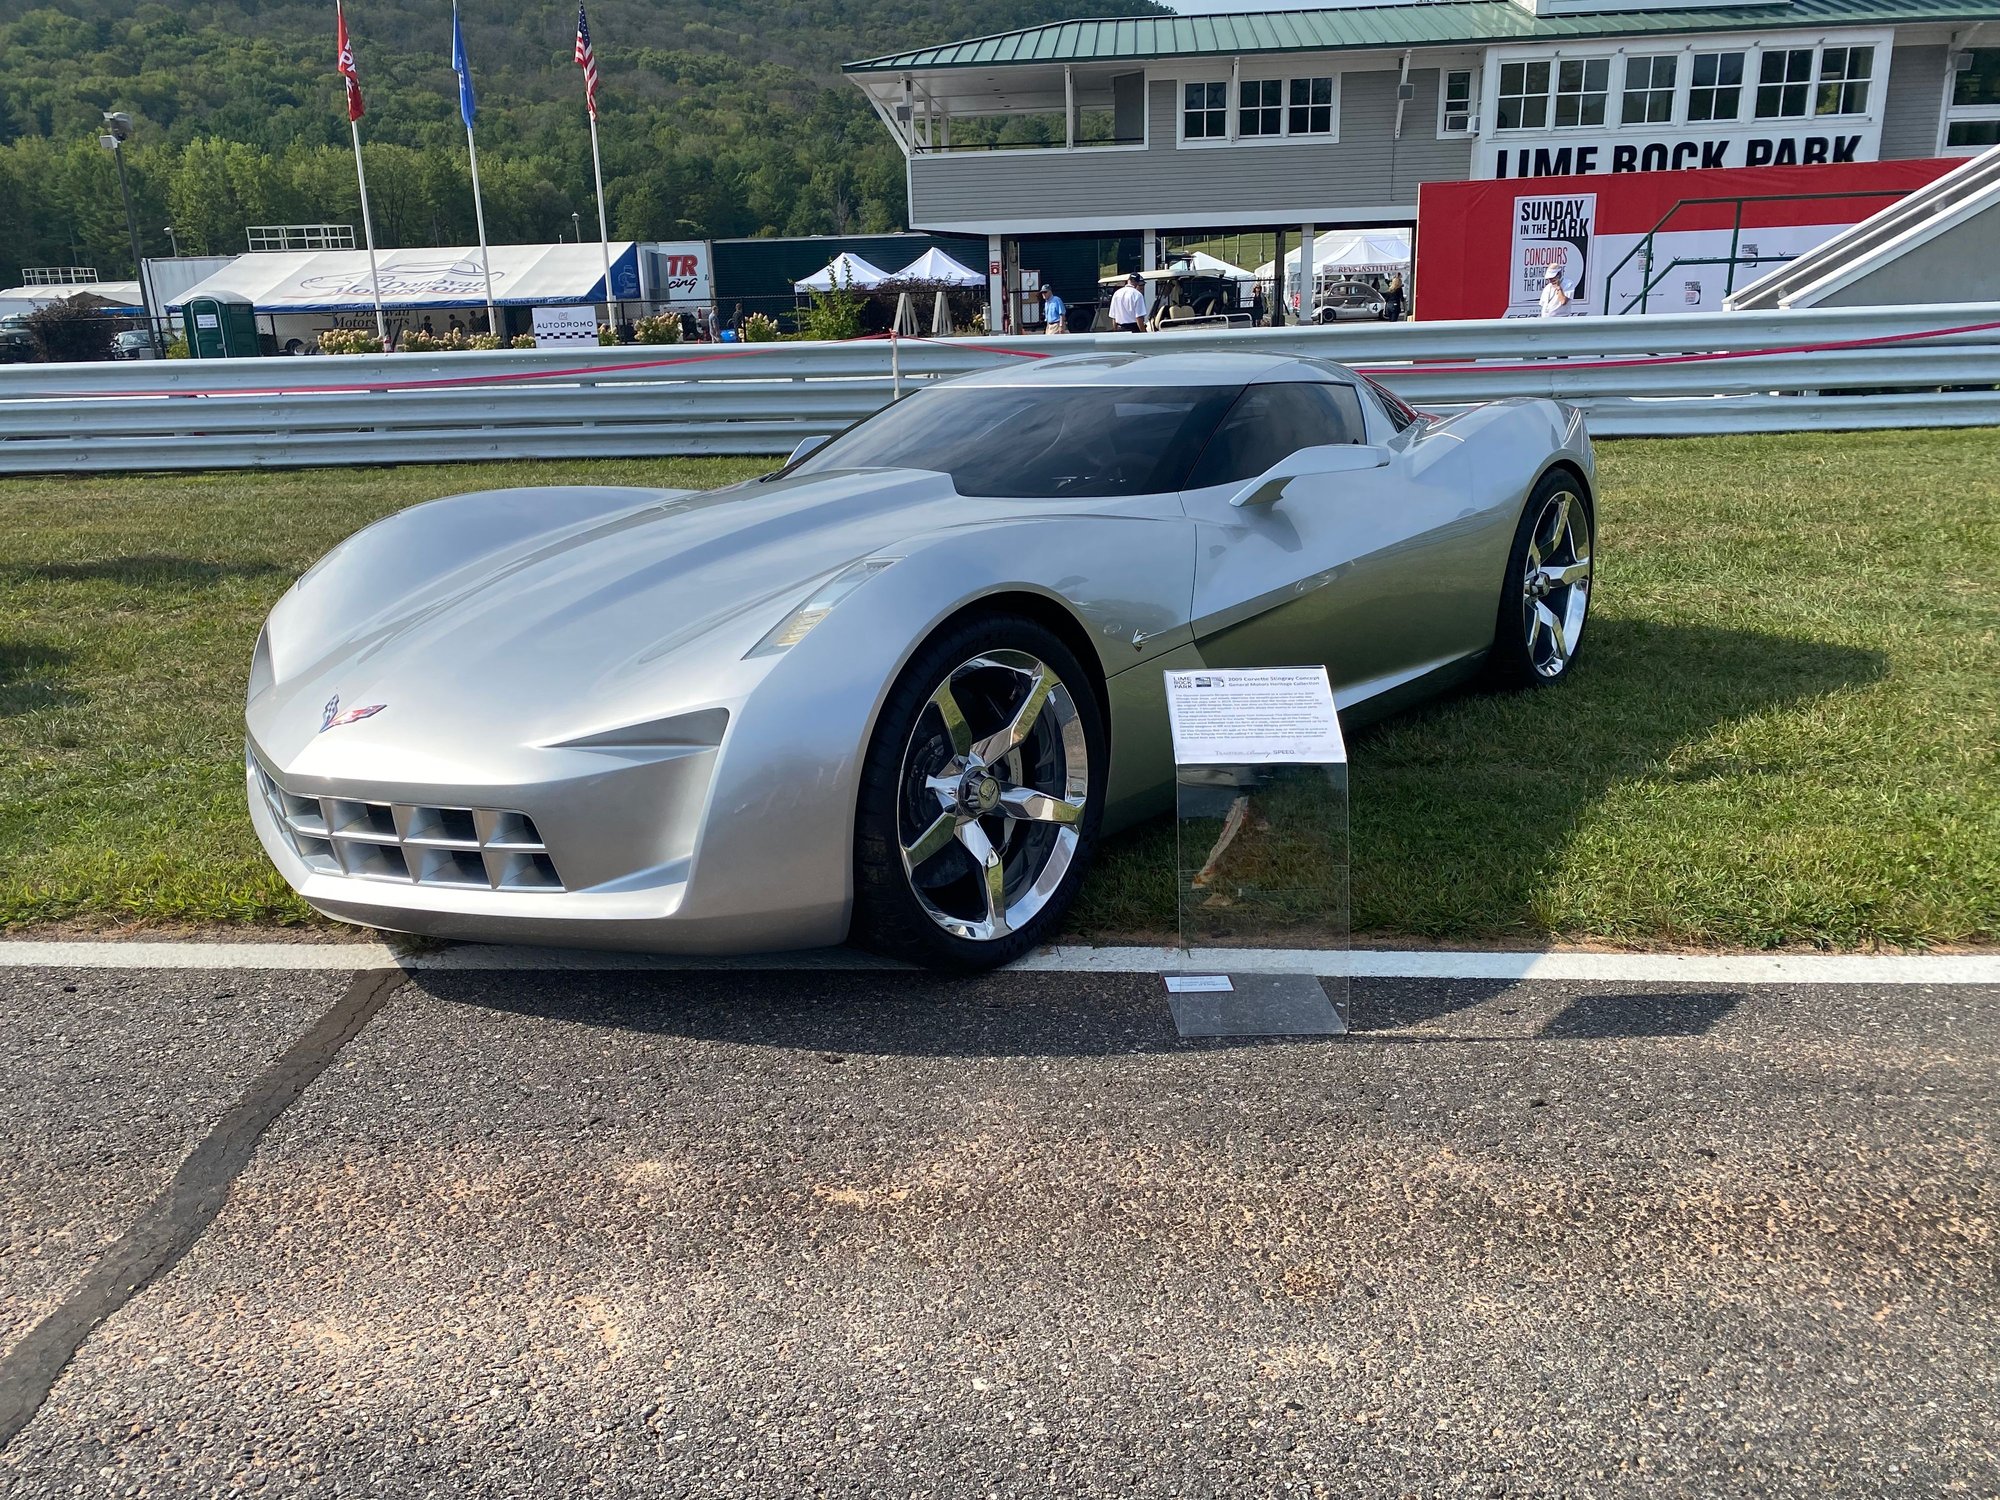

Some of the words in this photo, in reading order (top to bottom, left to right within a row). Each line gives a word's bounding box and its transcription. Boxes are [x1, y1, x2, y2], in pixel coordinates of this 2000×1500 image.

[1612, 140, 1730, 173] ROCK
[1745, 134, 1863, 167] PARK
[1521, 200, 1584, 221] SUNDAY
[1520, 224, 1529, 235] IN
[1532, 223, 1547, 234] THE
[1548, 218, 1589, 238] PARK
[1524, 246, 1568, 266] CONCOURS
[1358, 264, 1399, 273] INSTITUTE
[1524, 267, 1528, 278] &
[1524, 279, 1535, 292] THE
[1372, 303, 1379, 312] 4
[536, 320, 595, 329] AUTODROMO
